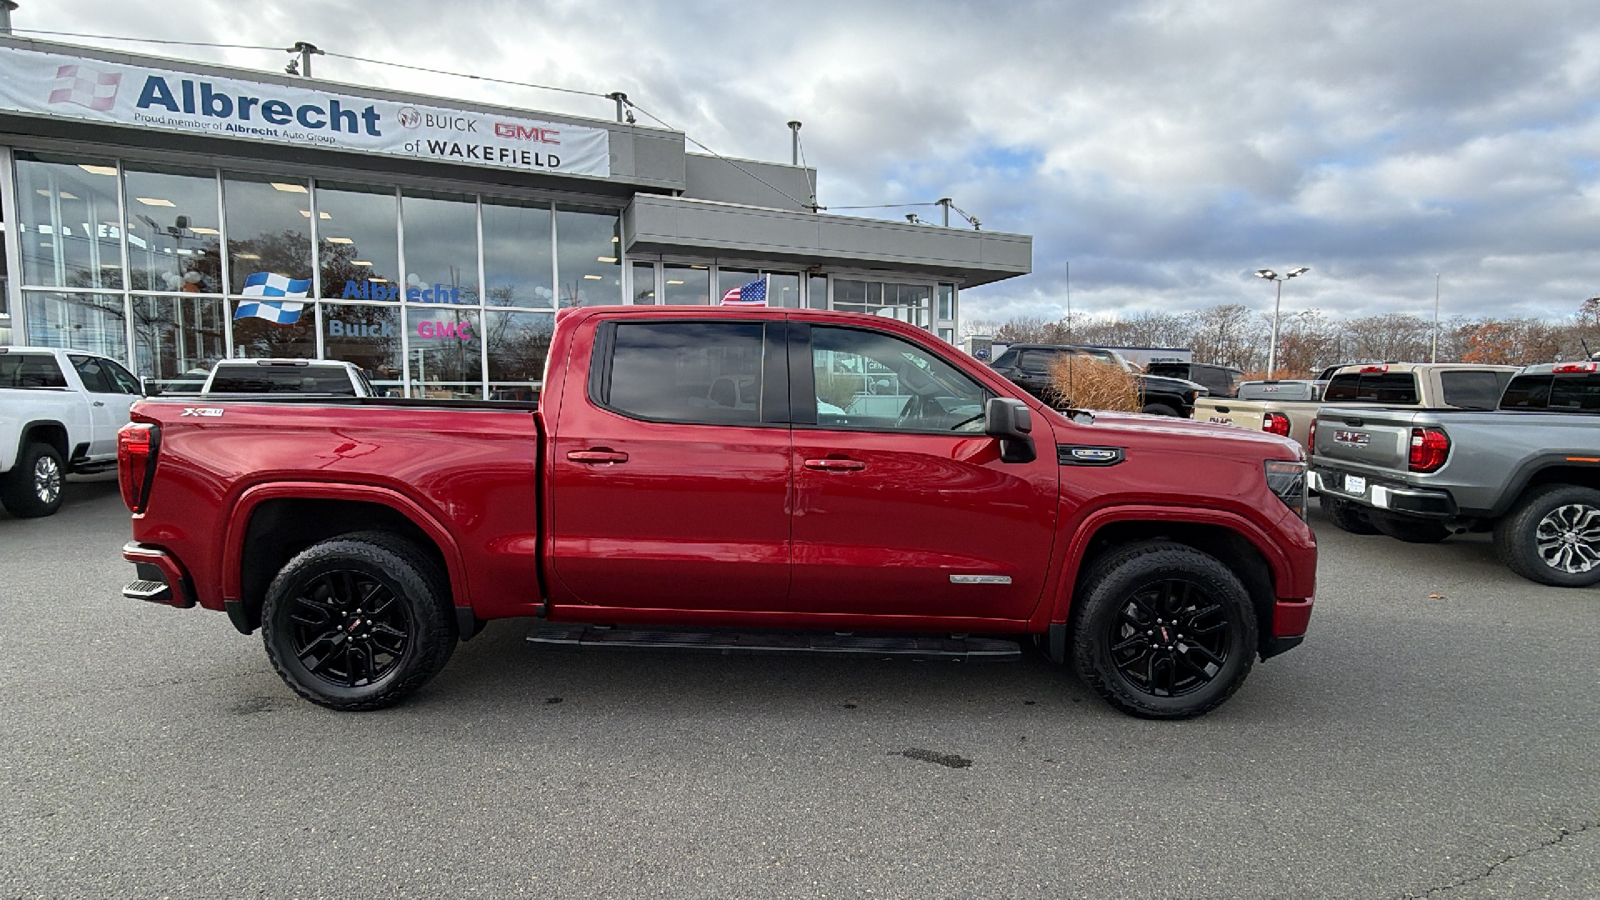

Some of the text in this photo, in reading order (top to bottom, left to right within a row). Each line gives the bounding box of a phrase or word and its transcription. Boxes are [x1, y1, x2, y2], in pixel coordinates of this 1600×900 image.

[136, 75, 382, 137] Albrecht
[134, 112, 336, 145] Proud member of Albrecht Auto Group
[426, 114, 561, 146] BUICK GMC
[404, 139, 561, 168] of WAKEFIELD
[343, 280, 460, 304] Albrecht
[329, 319, 472, 340] Buick GMC
